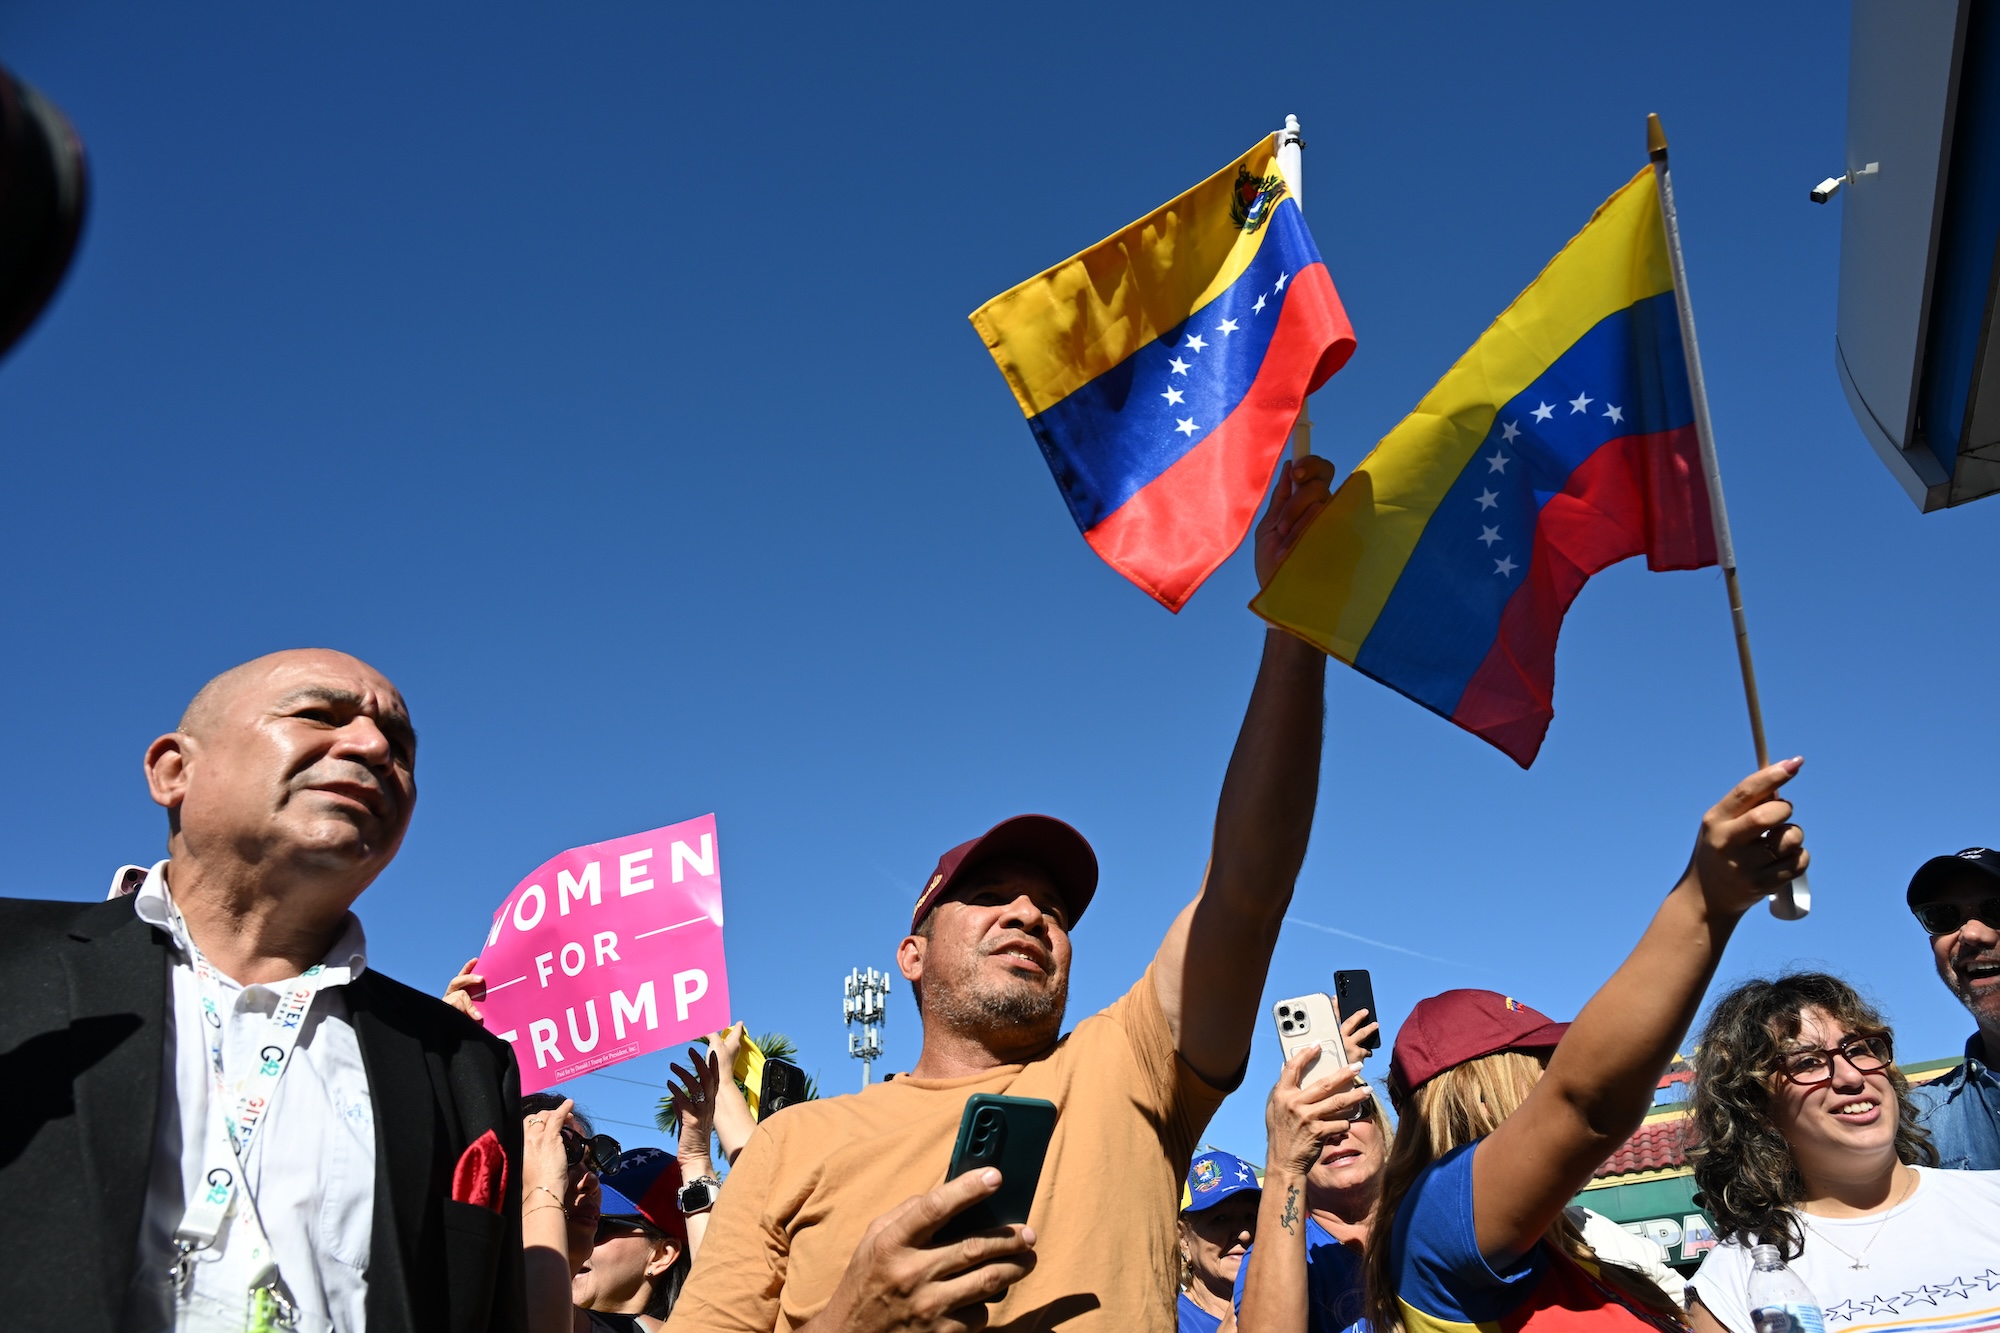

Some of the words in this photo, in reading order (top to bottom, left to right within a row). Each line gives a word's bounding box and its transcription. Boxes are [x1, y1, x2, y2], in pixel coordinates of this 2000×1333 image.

[535, 931, 621, 988] FOR
[282, 989, 310, 1029] GITEX
[260, 1045, 285, 1077] G42
[206, 1167, 233, 1204] G42
